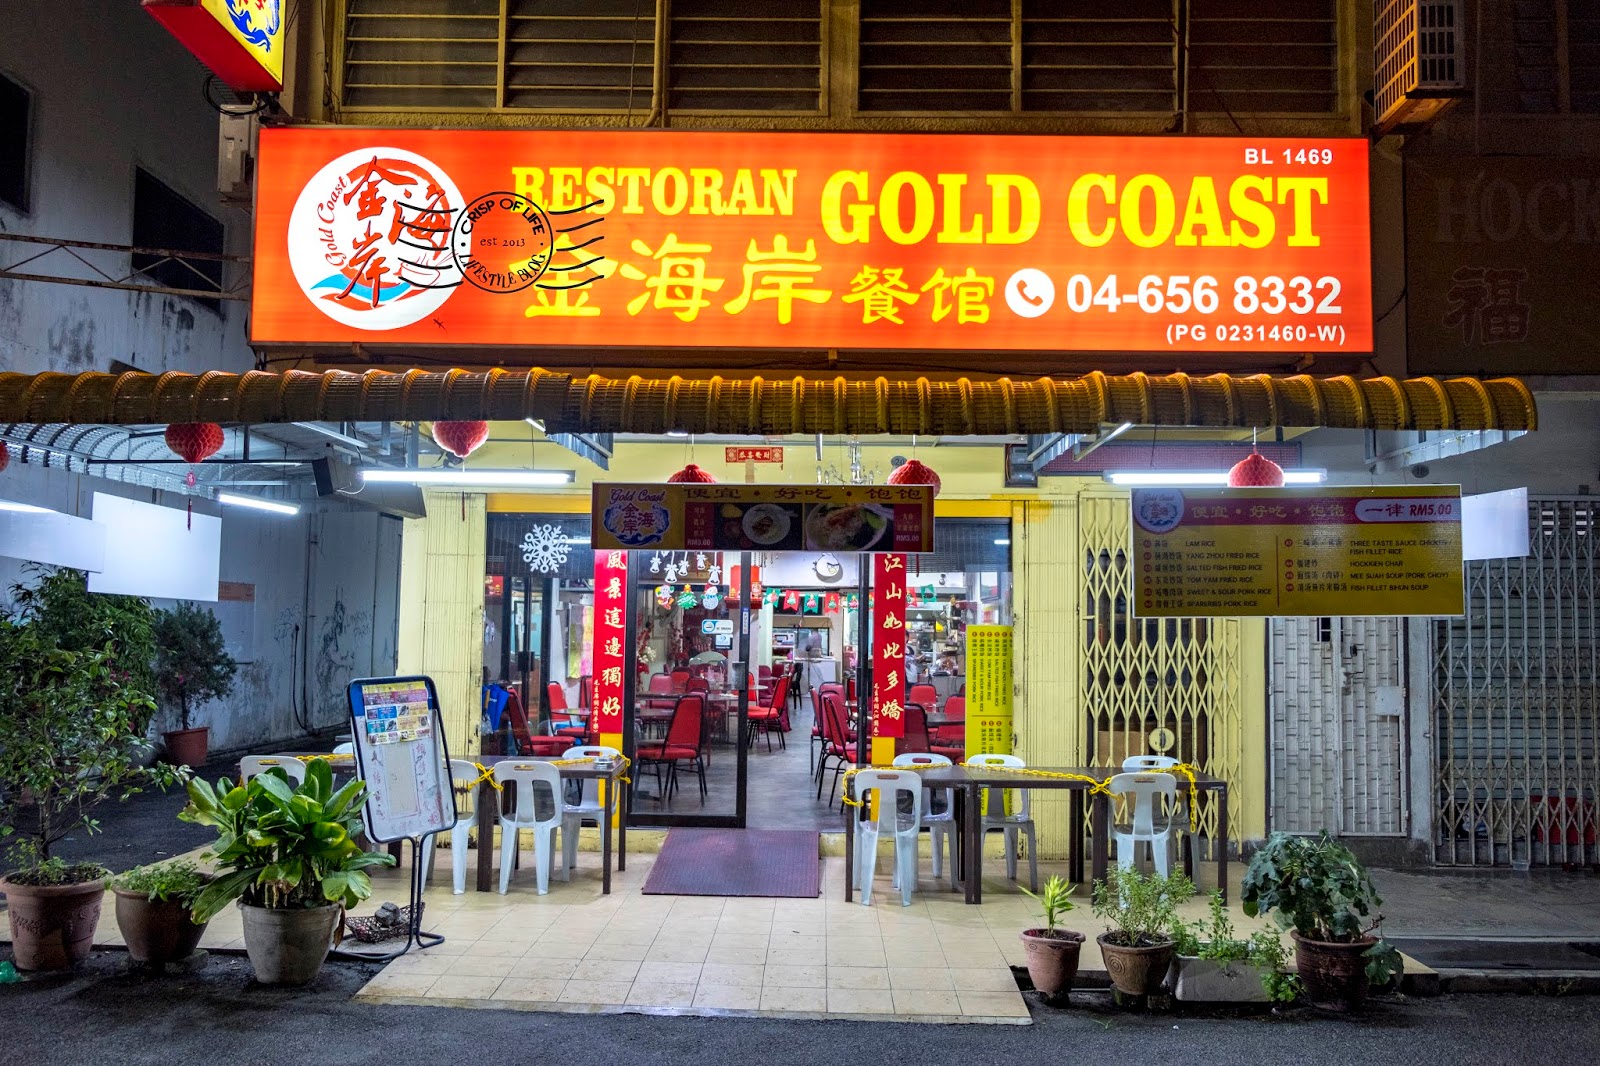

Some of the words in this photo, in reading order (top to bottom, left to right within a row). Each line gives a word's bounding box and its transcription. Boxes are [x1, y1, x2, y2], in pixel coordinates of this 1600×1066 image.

[1244, 149, 1274, 165] BL
[1282, 149, 1333, 166] 1469
[317, 175, 348, 224] Coast
[511, 166, 797, 216] RESTORAN
[820, 170, 1041, 246] GOLD
[1067, 172, 1328, 249] COAST
[318, 227, 346, 266] Gold
[1066, 274, 1219, 314] 04-656
[1233, 275, 1342, 315] 8332
[1166, 324, 1207, 345] (PG
[1215, 324, 1346, 346] 0231460-W)
[610, 488, 634, 504] Gold
[638, 488, 666, 502] Coast
[774, 488, 832, 500] 好吃
[1250, 504, 1288, 518] 好吃
[1409, 504, 1452, 516] RM5.00
[881, 554, 904, 720] 江山如此多嬌
